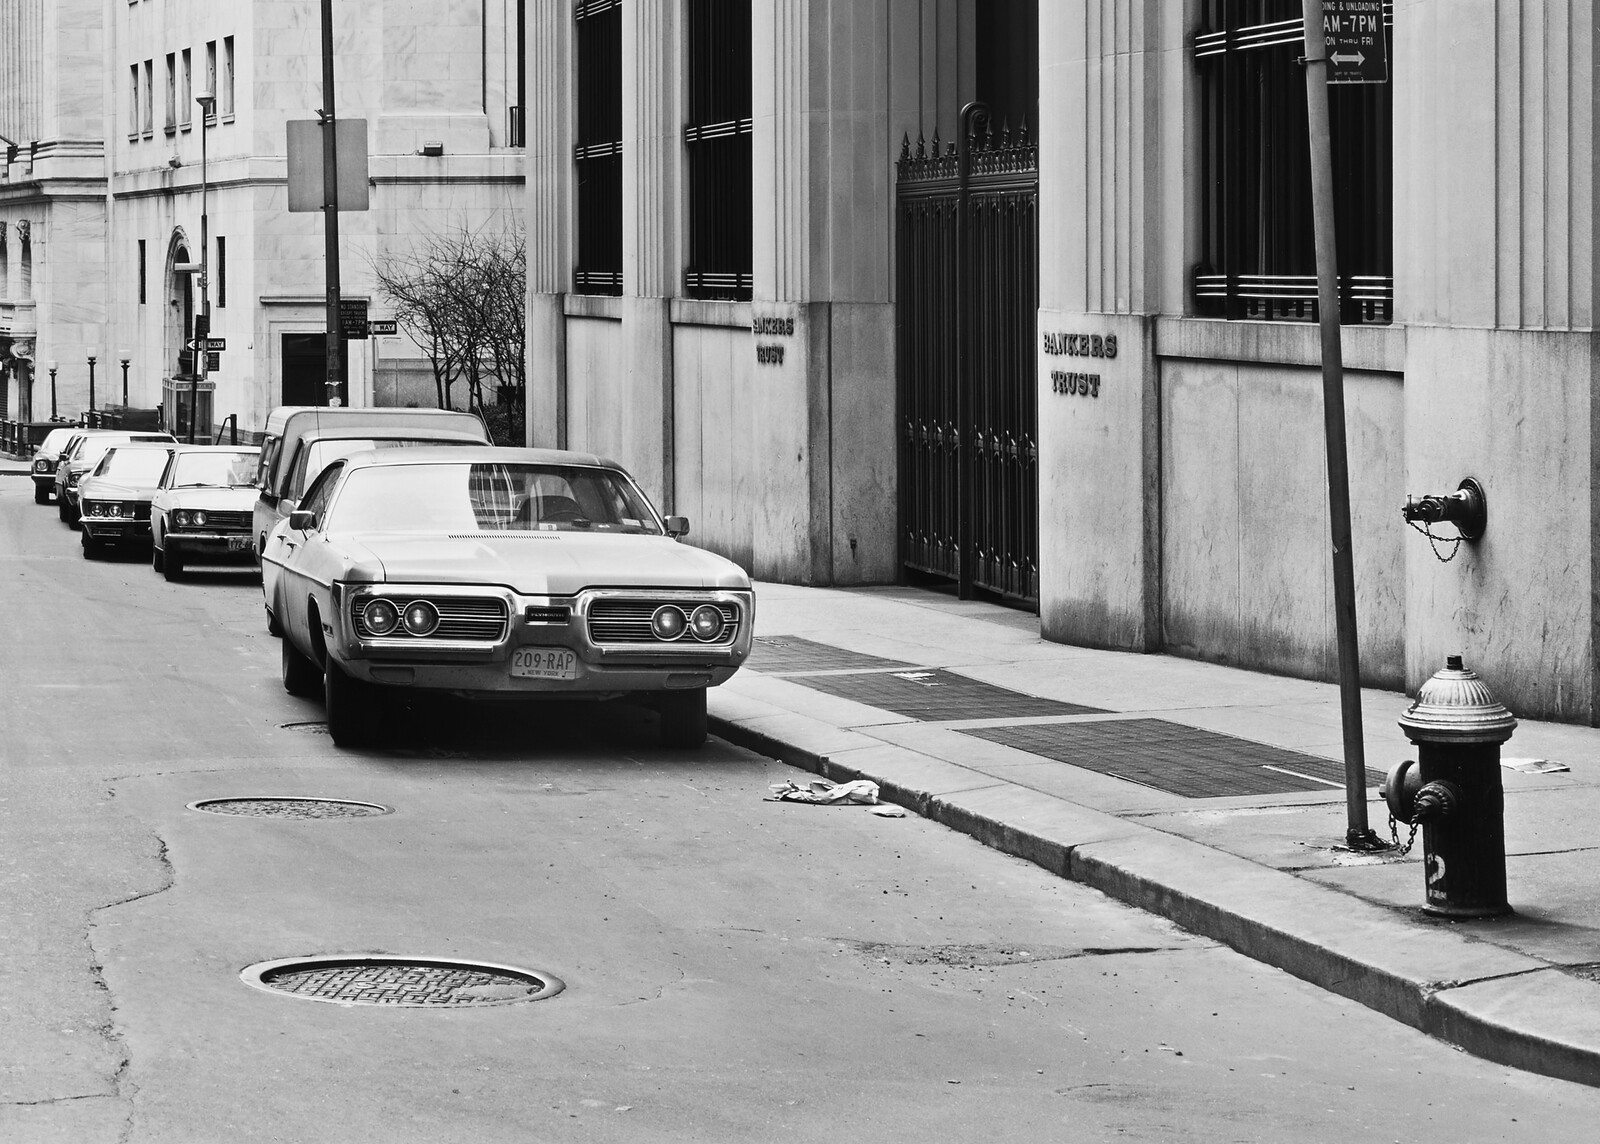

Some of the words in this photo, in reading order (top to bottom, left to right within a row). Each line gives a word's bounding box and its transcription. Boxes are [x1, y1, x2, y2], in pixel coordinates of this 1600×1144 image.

[1339, 1, 1344, 11] &
[1345, 1, 1380, 11] UNLOADING
[1323, 15, 1377, 33] AM-7PM
[1325, 36, 1336, 46] ON
[1361, 36, 1373, 46] FRI
[756, 345, 784, 364] TRUST
[1043, 332, 1117, 359] BANKERS
[1051, 370, 1100, 397] TRUST
[514, 651, 574, 670] 209-RAP
